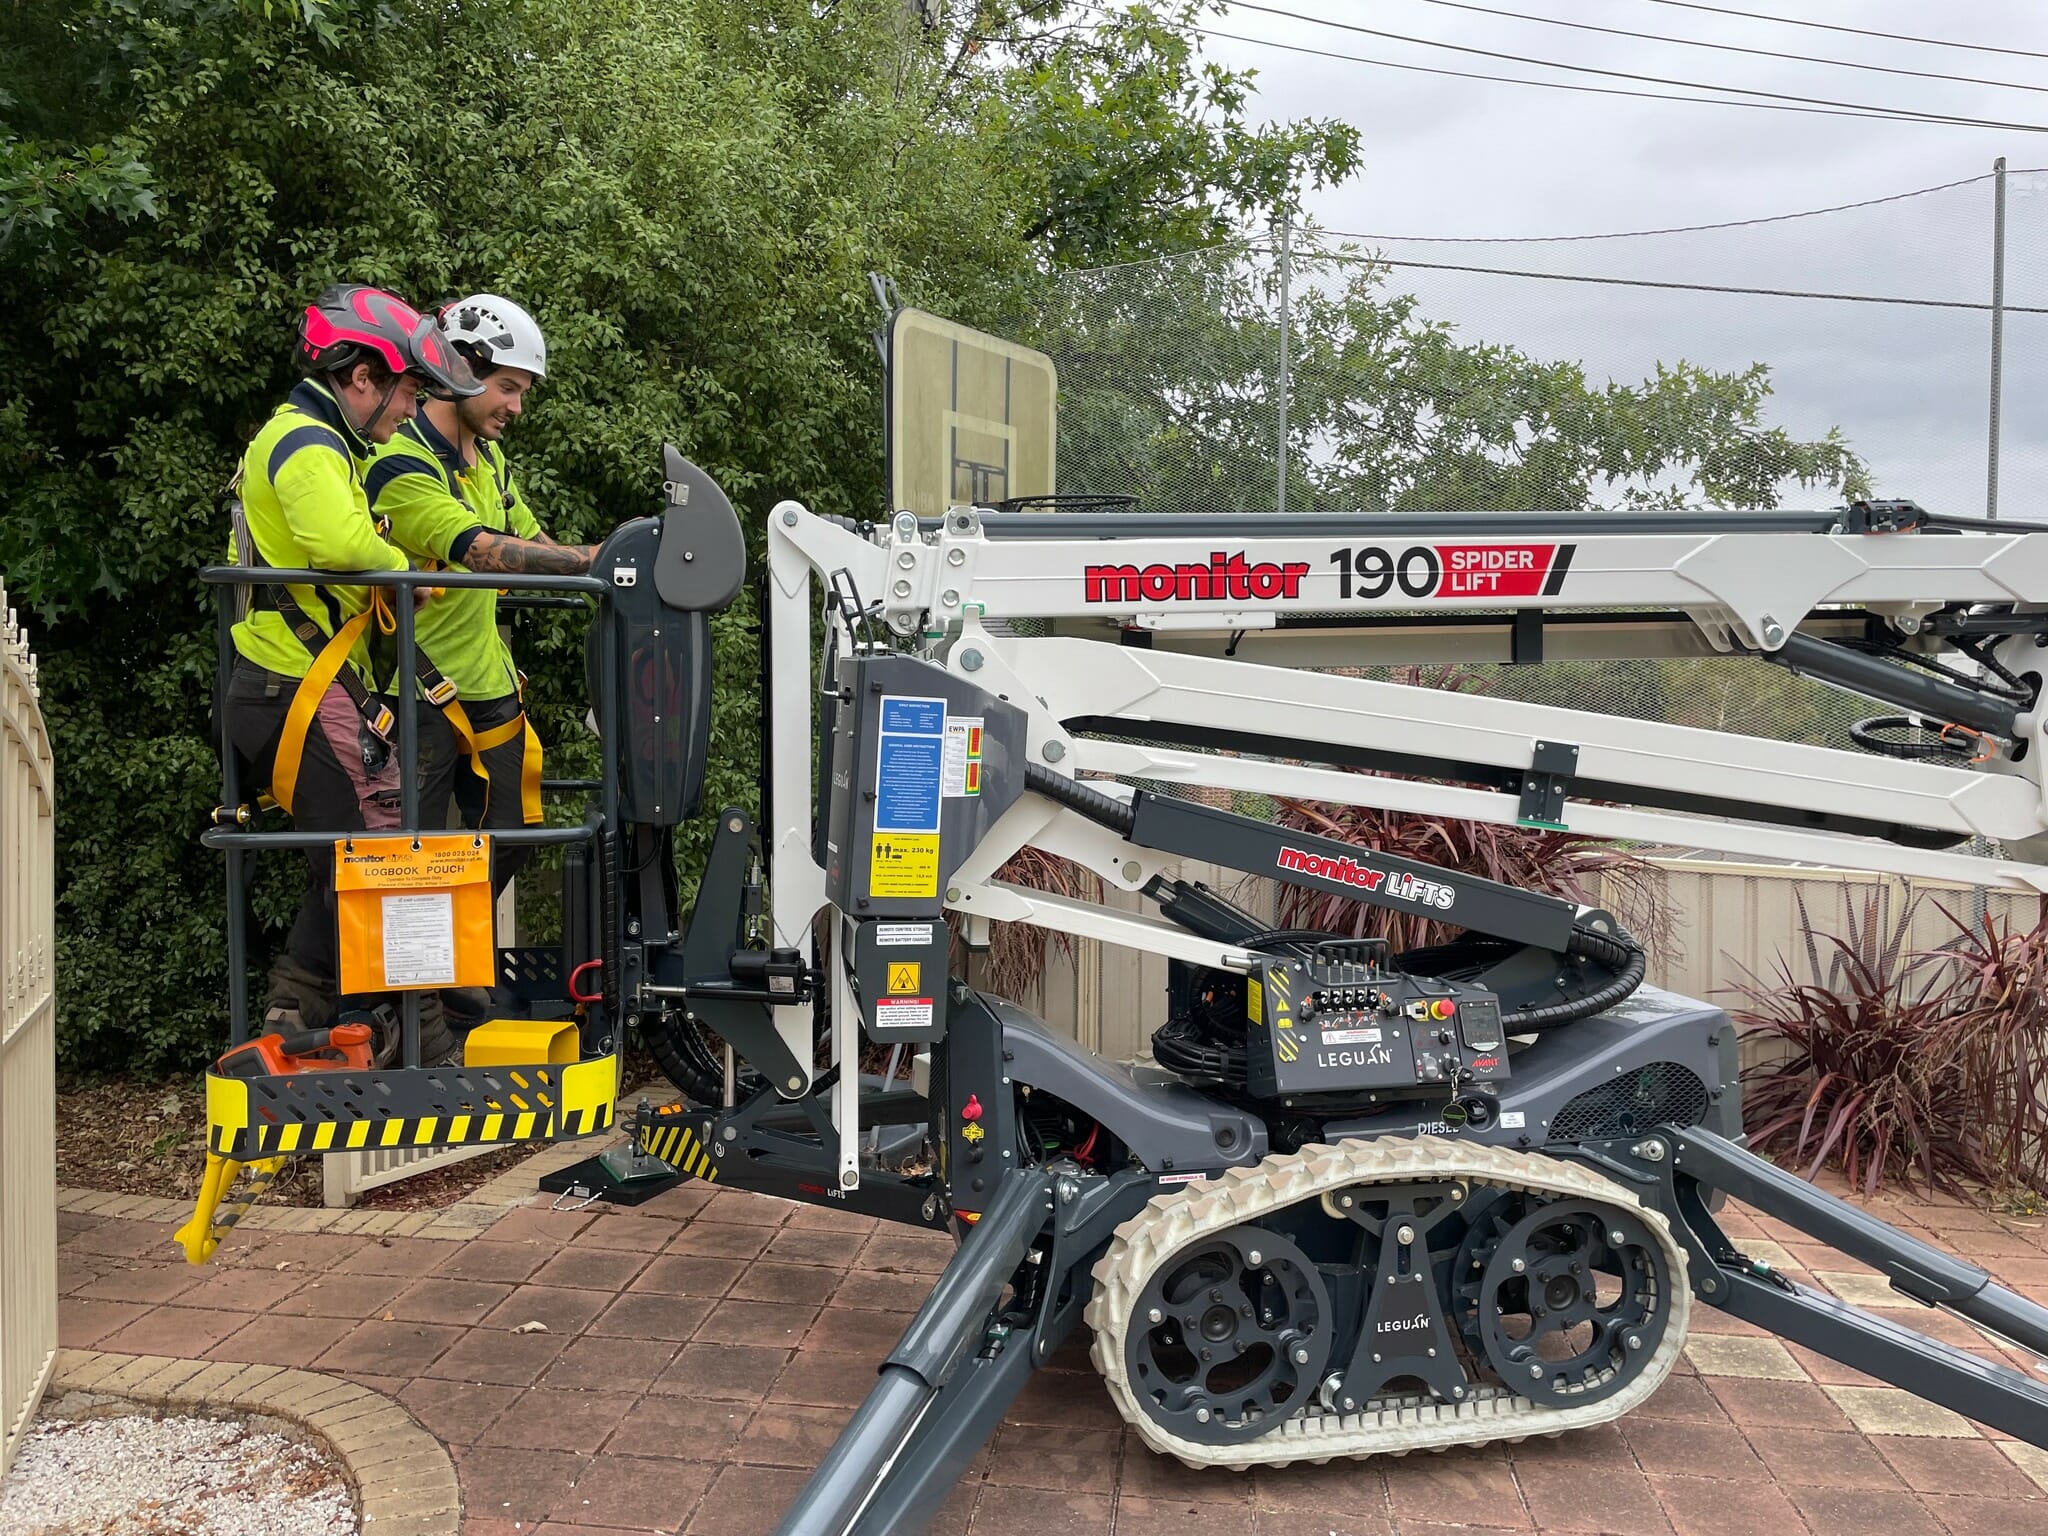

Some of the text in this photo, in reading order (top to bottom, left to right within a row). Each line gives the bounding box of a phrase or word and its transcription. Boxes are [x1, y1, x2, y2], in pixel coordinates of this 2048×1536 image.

[1084, 546, 1535, 603] monitor 190 SPIDER
[1451, 572, 1503, 593] LIFT
[343, 853, 386, 864] monitor
[364, 864, 465, 876] LOGBOOK POUCH
[1277, 846, 1385, 892] monitor
[1472, 1057, 1500, 1069] AVANT
[1377, 1313, 1429, 1333] LEGUAN
